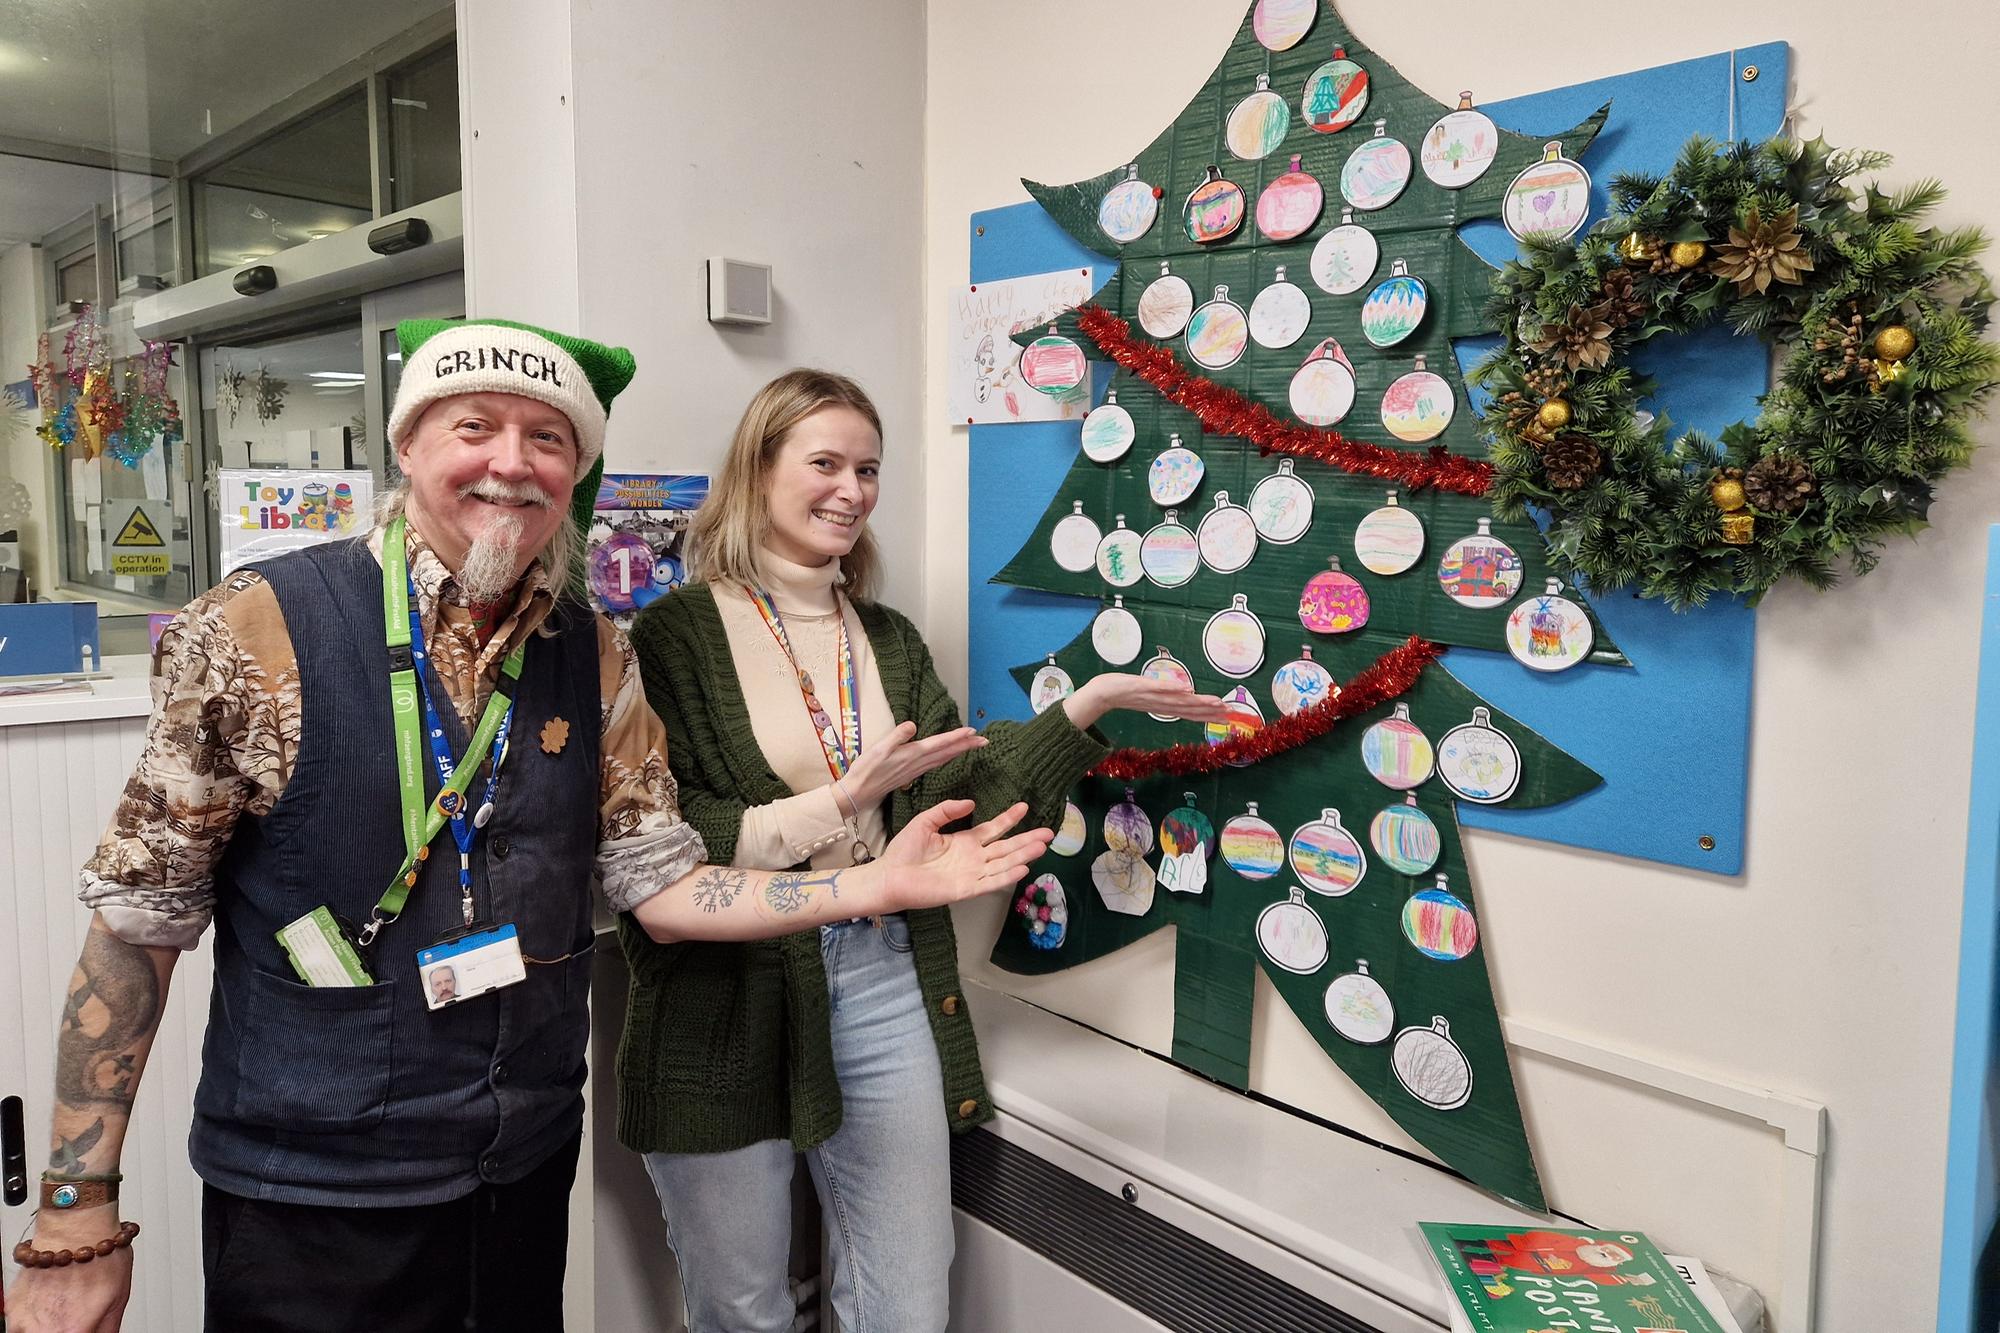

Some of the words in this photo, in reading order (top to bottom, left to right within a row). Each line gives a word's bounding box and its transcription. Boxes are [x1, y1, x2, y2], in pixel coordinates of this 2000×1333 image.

[435, 346, 561, 388] GRINCH
[244, 481, 294, 506] Toy
[614, 489, 671, 499] POSSIBILITIES
[621, 479, 657, 488] LIBRARY
[630, 499, 663, 508] WONDER
[239, 506, 357, 534] Library
[115, 565, 165, 574] operation
[119, 555, 149, 564] CCTV
[152, 555, 161, 563] in
[610, 547, 631, 595] 1
[842, 708, 859, 760] STAFF
[1514, 1276, 1582, 1330] POST
[1554, 1276, 1622, 1333] SANT
